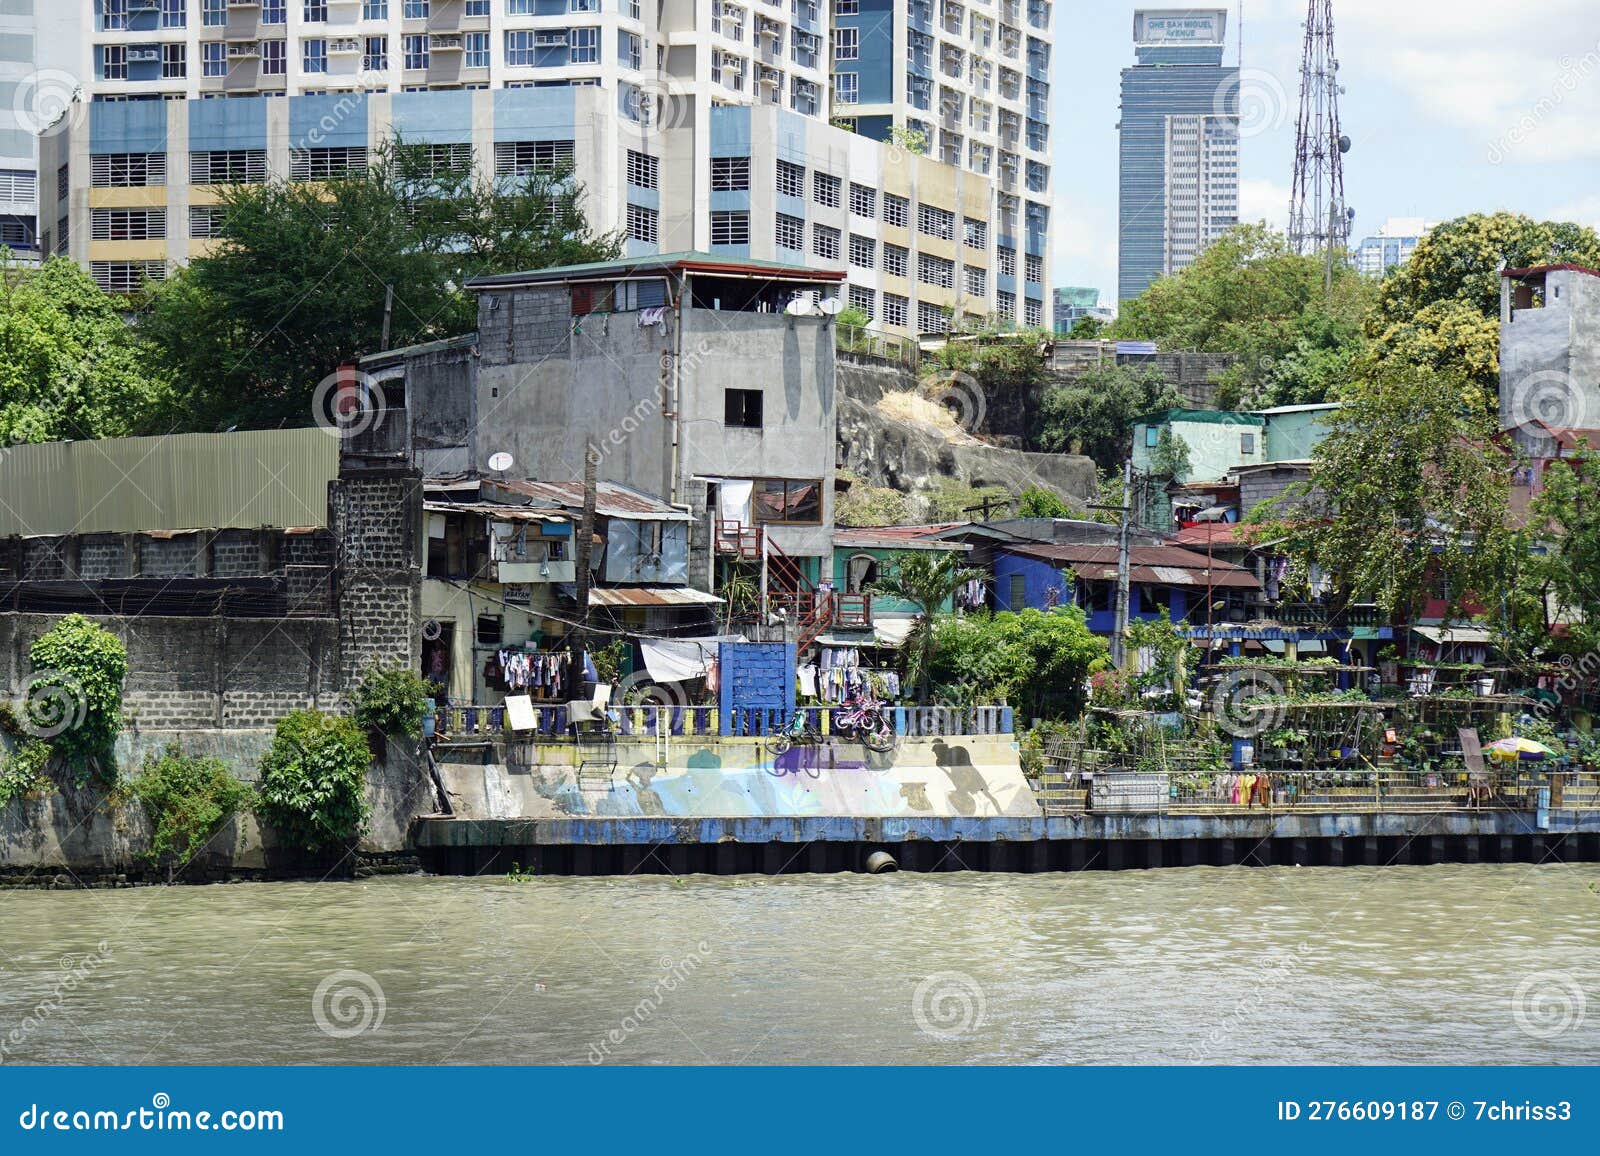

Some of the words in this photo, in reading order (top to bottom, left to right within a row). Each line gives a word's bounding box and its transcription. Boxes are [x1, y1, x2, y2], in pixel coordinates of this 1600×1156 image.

[1148, 20, 1165, 28] ONE
[1167, 20, 1182, 28] SAN
[1184, 20, 1213, 28] MIGUEL
[1166, 29, 1196, 37] AVENUE
